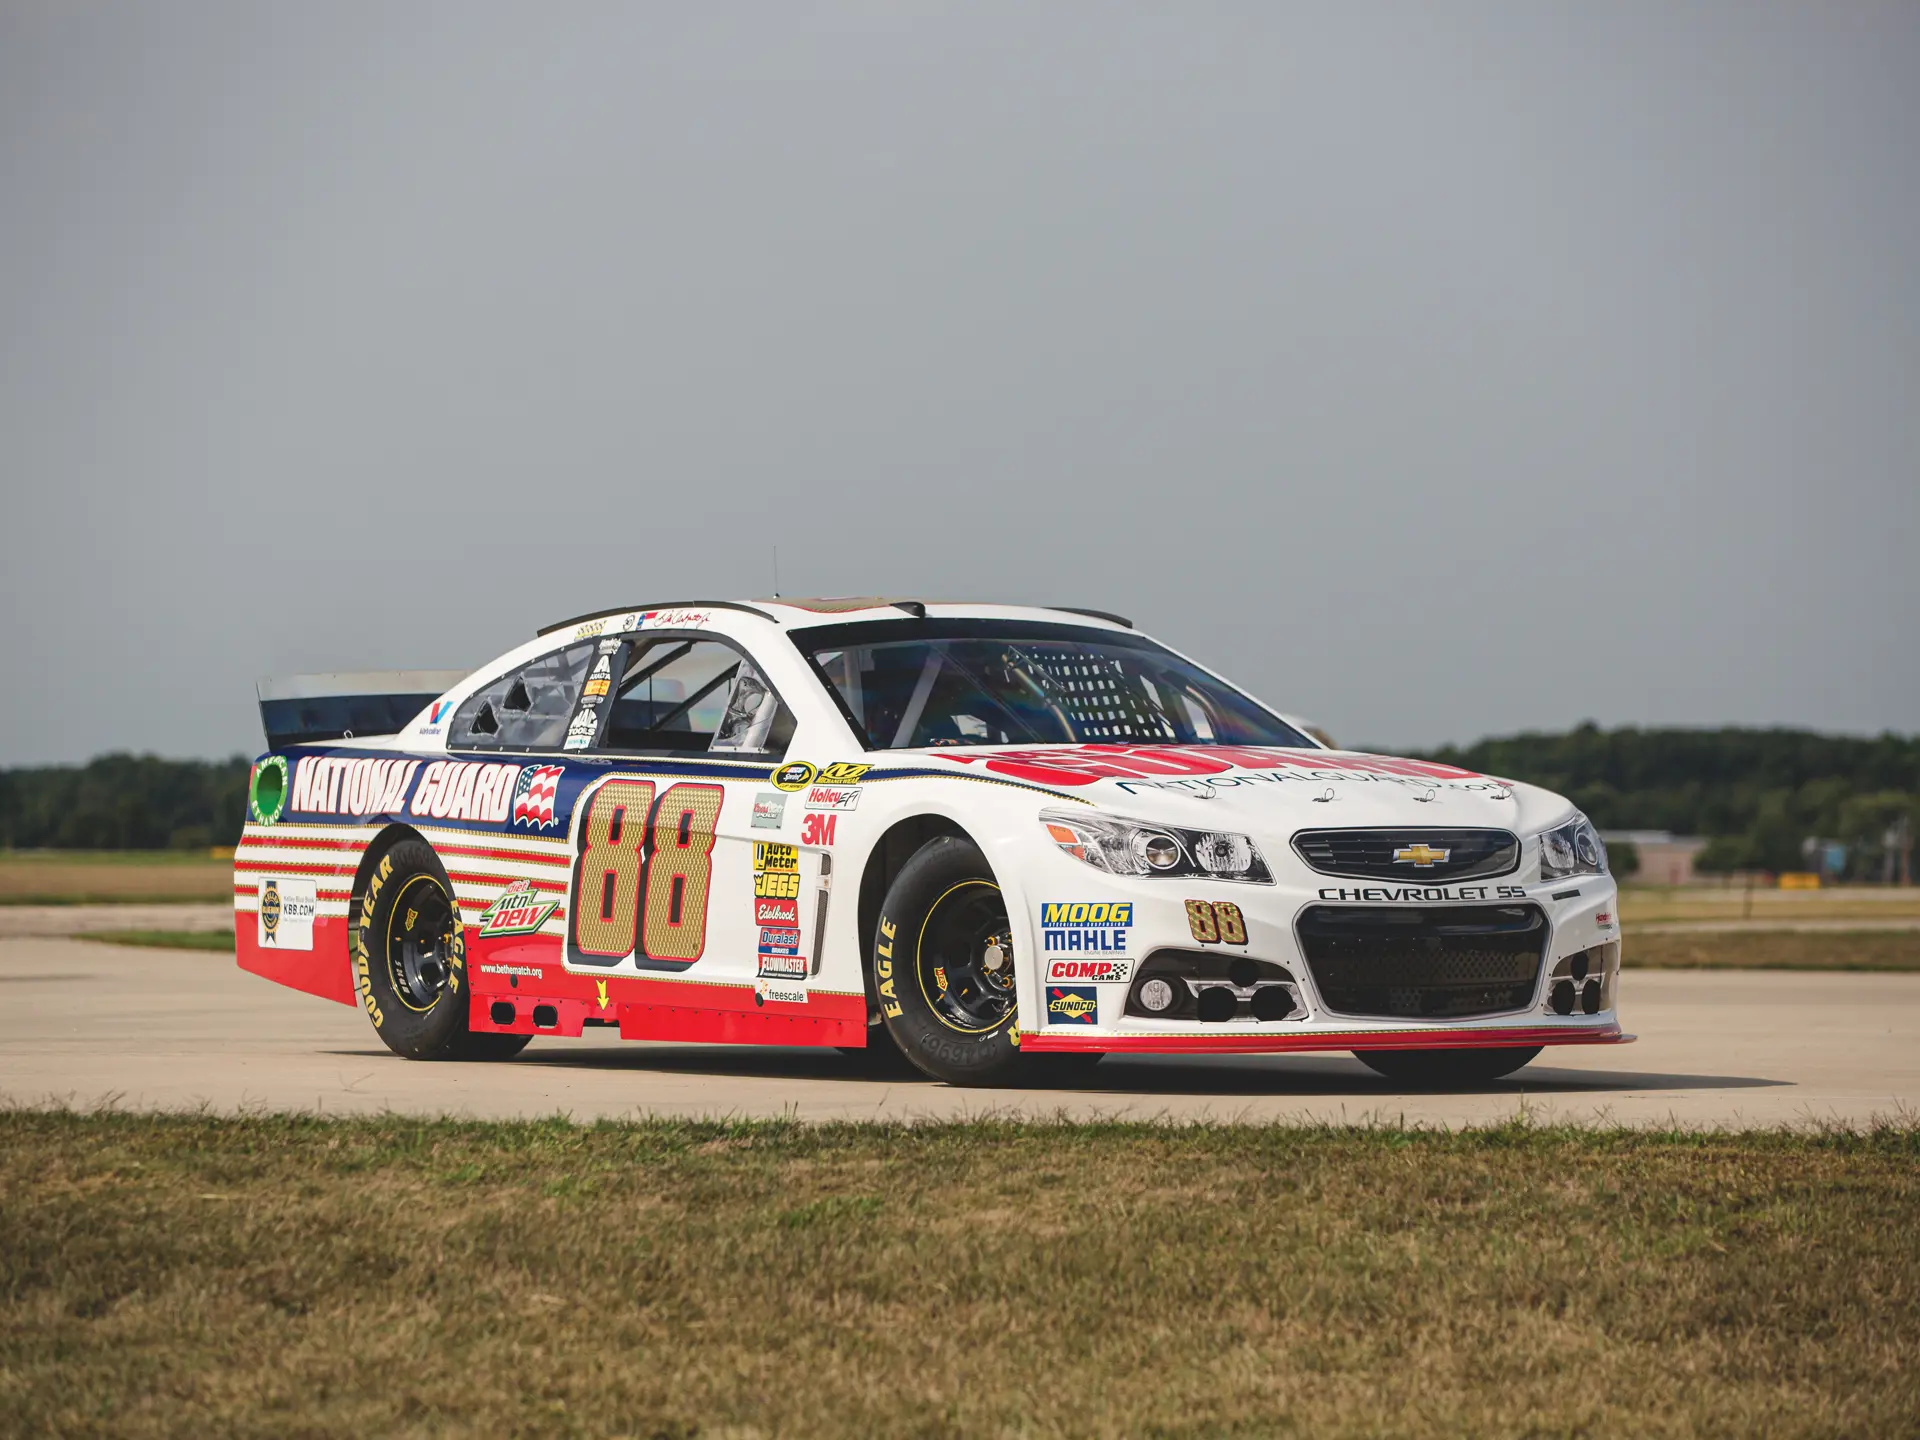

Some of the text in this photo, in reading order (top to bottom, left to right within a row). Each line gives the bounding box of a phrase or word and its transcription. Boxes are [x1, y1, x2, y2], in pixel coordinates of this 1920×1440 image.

[568, 727, 596, 736] TOOLS
[256, 755, 288, 786] AMERICAN
[783, 773, 802, 782] Sprint
[291, 755, 521, 823] NATIONAL GUARD
[808, 788, 841, 807] Holley
[252, 800, 283, 827] ETHANOL
[801, 813, 838, 846] 3M
[566, 778, 724, 973] 88
[507, 882, 527, 894] diet
[755, 873, 800, 898] JEGS
[1318, 886, 1527, 901] CHEVROLET SS
[283, 904, 315, 917] KBB.COM
[758, 904, 796, 922] Edelbrock
[1044, 903, 1131, 923] MOOG
[1184, 899, 1249, 946] 88
[358, 854, 394, 1028] GOODYEAR
[448, 900, 465, 995] EAGLE
[762, 931, 798, 945] Duralast
[1044, 930, 1126, 951] MAHLE
[480, 964, 543, 979] www.bethematch.org
[760, 956, 805, 975] FLOWMASTER
[877, 916, 903, 1019] EAGLE
[1051, 962, 1113, 978] COMP
[768, 989, 805, 1002] freescale
[1051, 1001, 1094, 1011] SUNOCO
